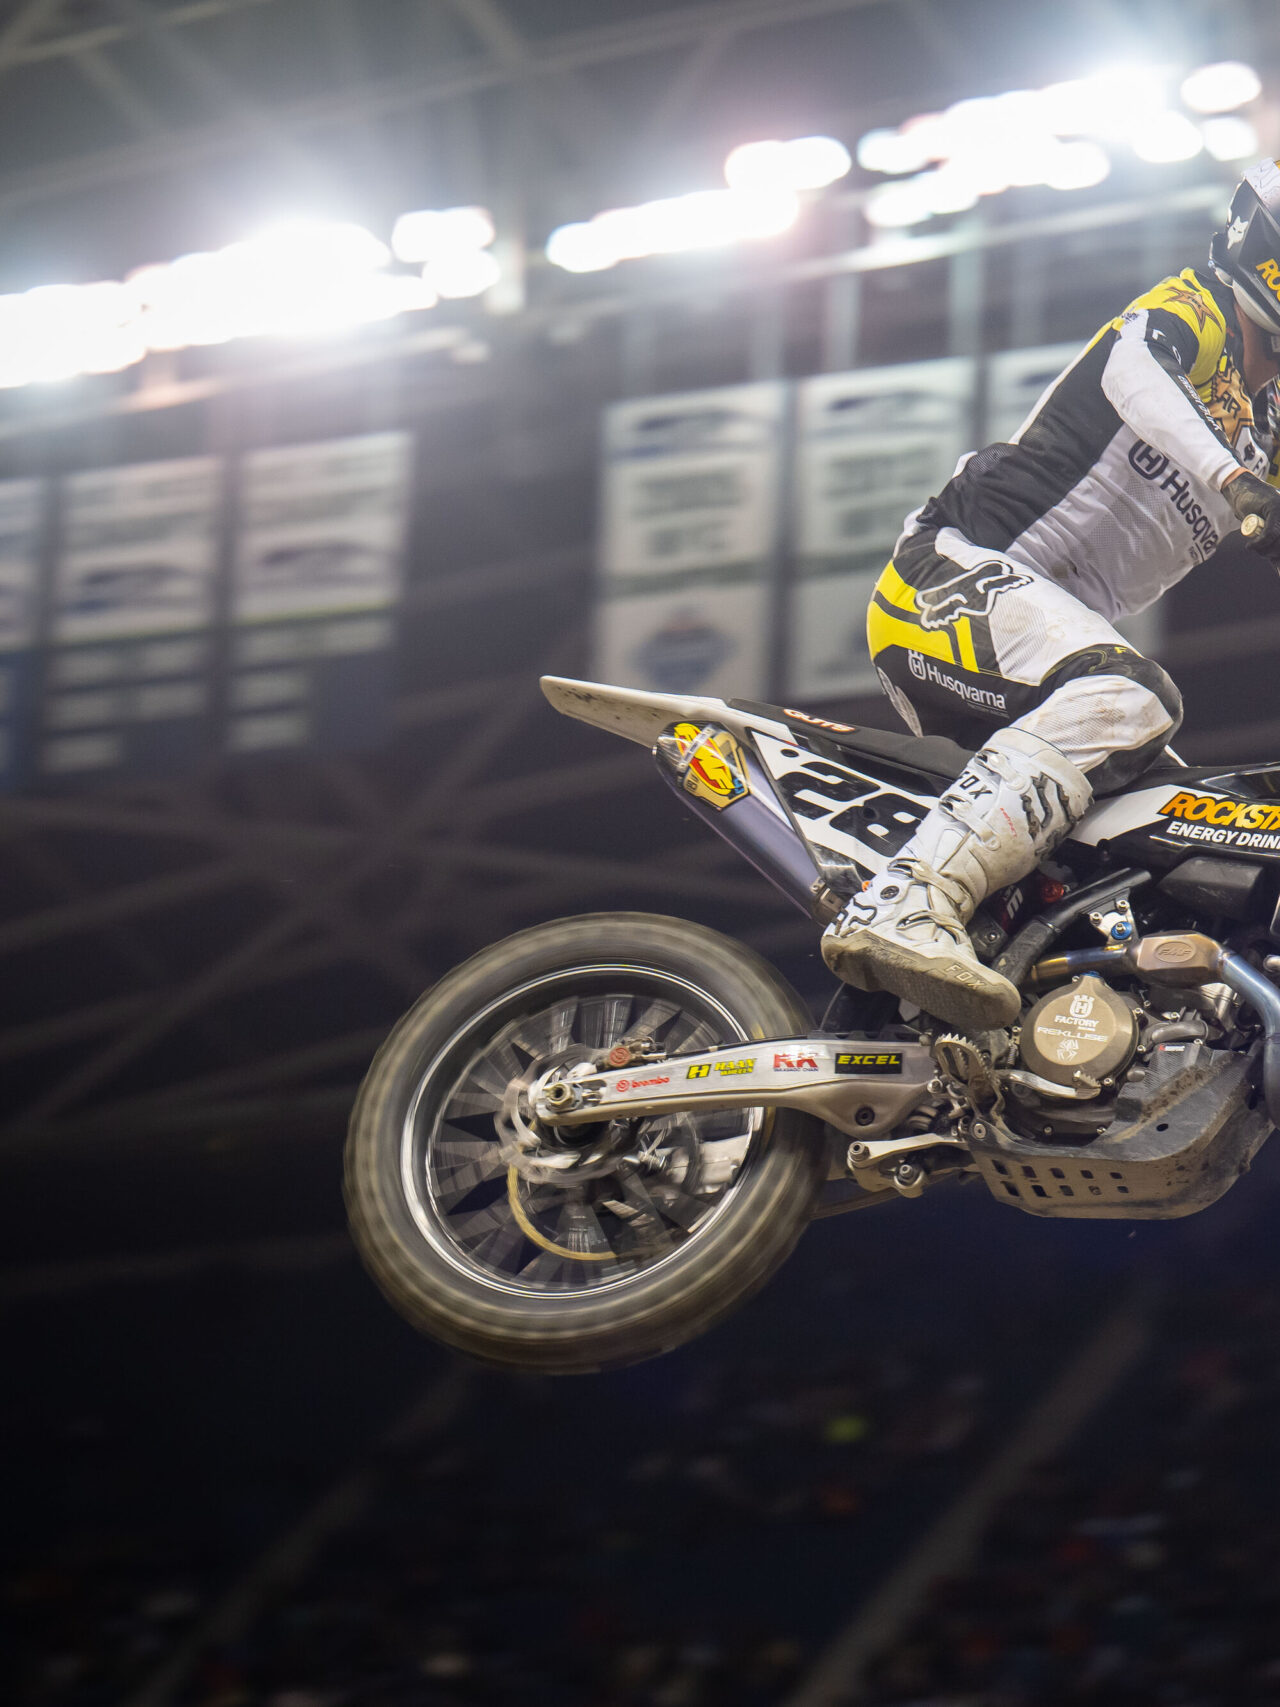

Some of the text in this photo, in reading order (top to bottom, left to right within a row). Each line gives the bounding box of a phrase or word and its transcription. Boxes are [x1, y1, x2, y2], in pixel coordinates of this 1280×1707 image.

[1160, 469, 1219, 554] Husqva
[926, 663, 1006, 710] Husqvarna
[784, 708, 855, 732] GUTS
[776, 761, 932, 858] 28
[1166, 821, 1238, 844] ENERGY
[946, 964, 985, 988] FOX
[1054, 1014, 1100, 1028] FACTORY
[1036, 1026, 1109, 1043] REKLUSE
[837, 1054, 900, 1065] EXCEL
